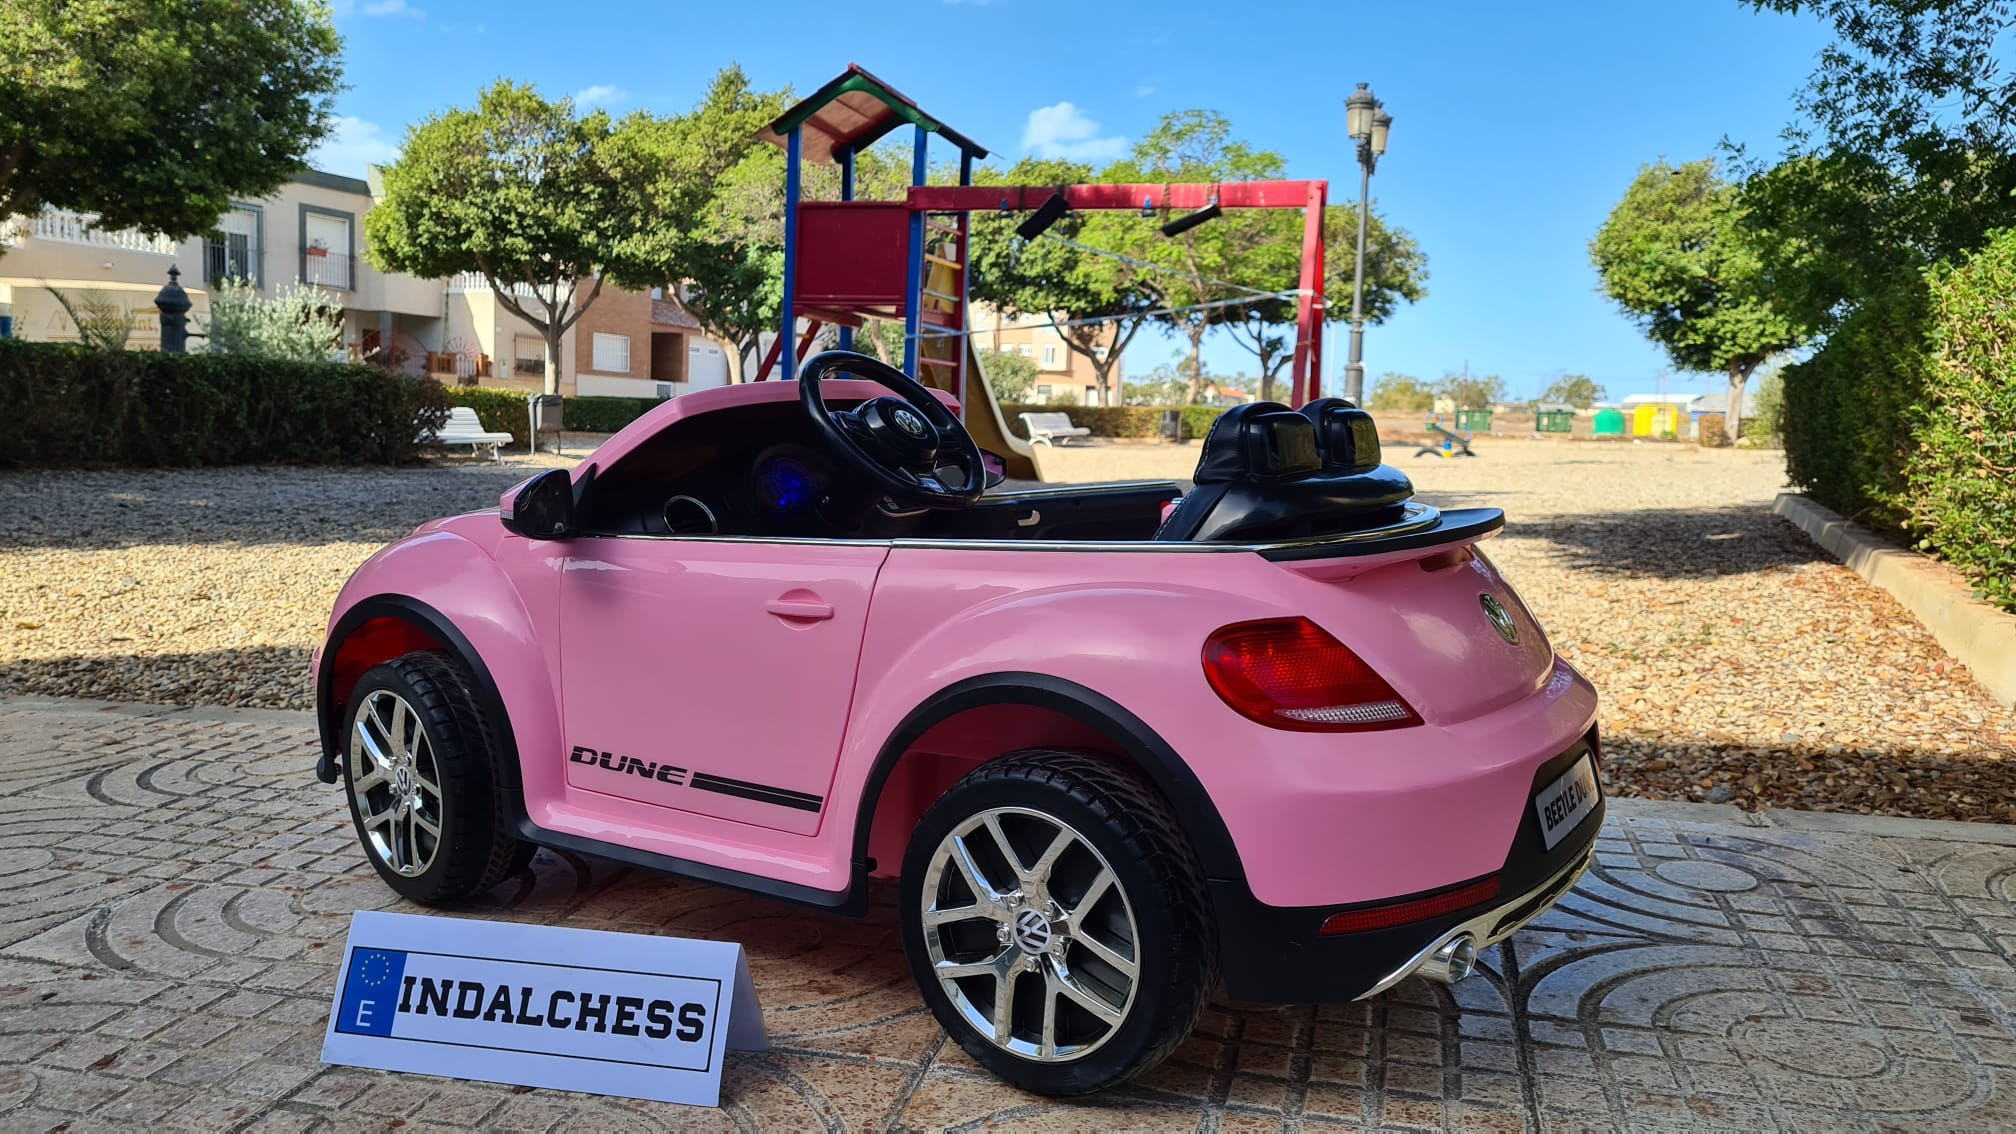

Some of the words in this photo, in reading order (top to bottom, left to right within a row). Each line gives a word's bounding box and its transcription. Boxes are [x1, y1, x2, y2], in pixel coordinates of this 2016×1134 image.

[570, 746, 687, 785] DUNE
[1544, 784, 1577, 832] BEETLE
[356, 1000, 375, 1028] E
[398, 976, 706, 1043] INDALCHESS
